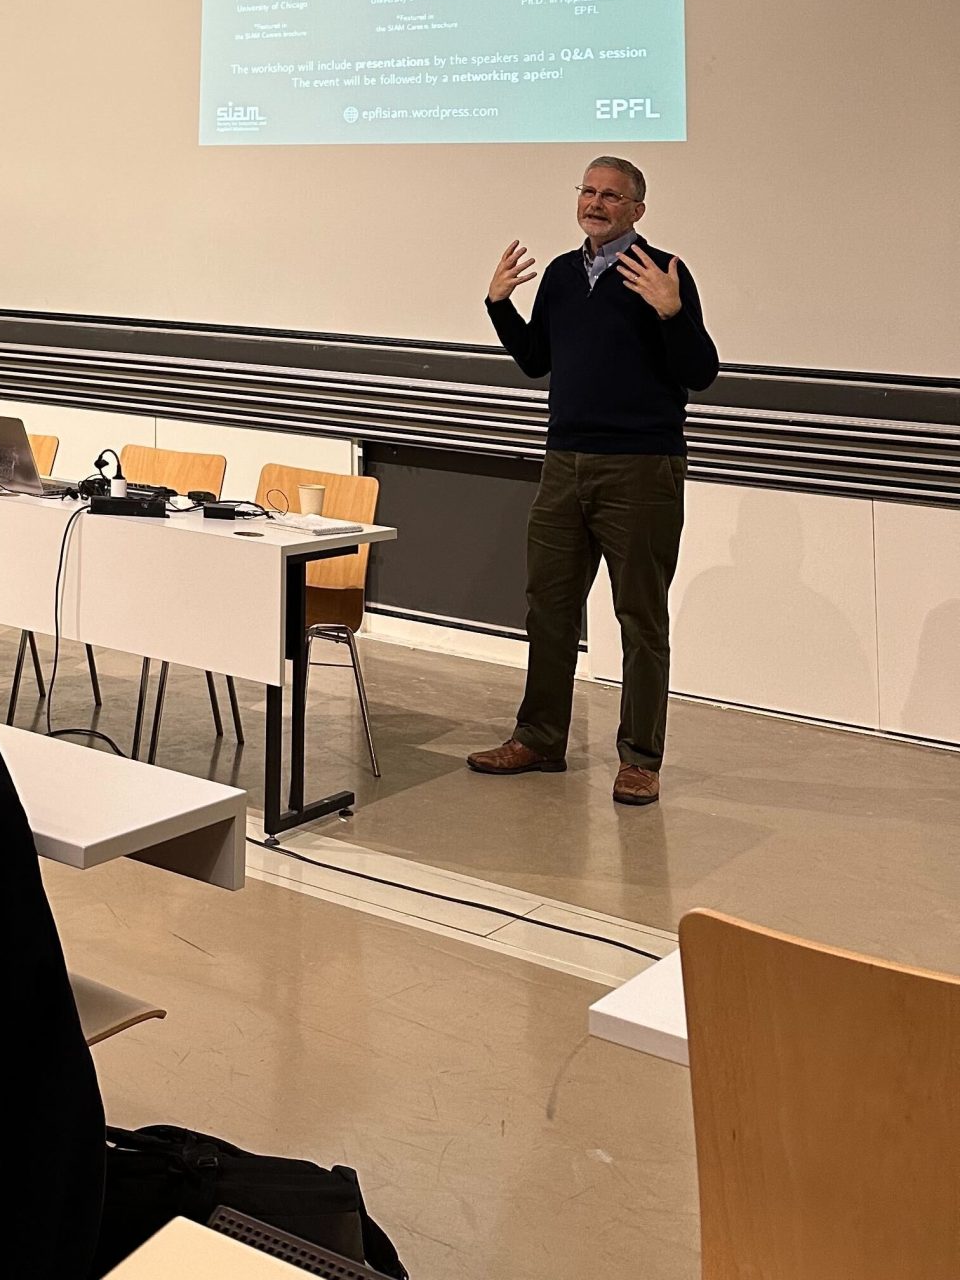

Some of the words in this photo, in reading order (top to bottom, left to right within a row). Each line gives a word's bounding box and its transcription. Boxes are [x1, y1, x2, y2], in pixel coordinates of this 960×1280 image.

[574, 6, 600, 15] EPFL
[231, 64, 249, 75] The
[251, 62, 295, 75] workshop
[298, 61, 314, 72] will
[317, 59, 352, 71] include
[355, 57, 430, 72] presentations
[434, 55, 446, 68] by
[450, 53, 468, 66] the
[471, 52, 519, 67] speakers
[523, 51, 544, 62] and
[549, 53, 555, 61] a
[560, 48, 594, 62] Q&A
[599, 47, 647, 59] session
[292, 77, 311, 88] The
[313, 77, 340, 88] event
[343, 76, 361, 87] will
[364, 75, 376, 86] be
[380, 73, 422, 85] followed
[426, 72, 438, 86] by
[442, 74, 448, 83] a
[452, 70, 519, 83] networking
[523, 67, 564, 81] apéro!
[362, 106, 499, 122] epflsiam.wordpress.com
[595, 98, 661, 119] EPFL
